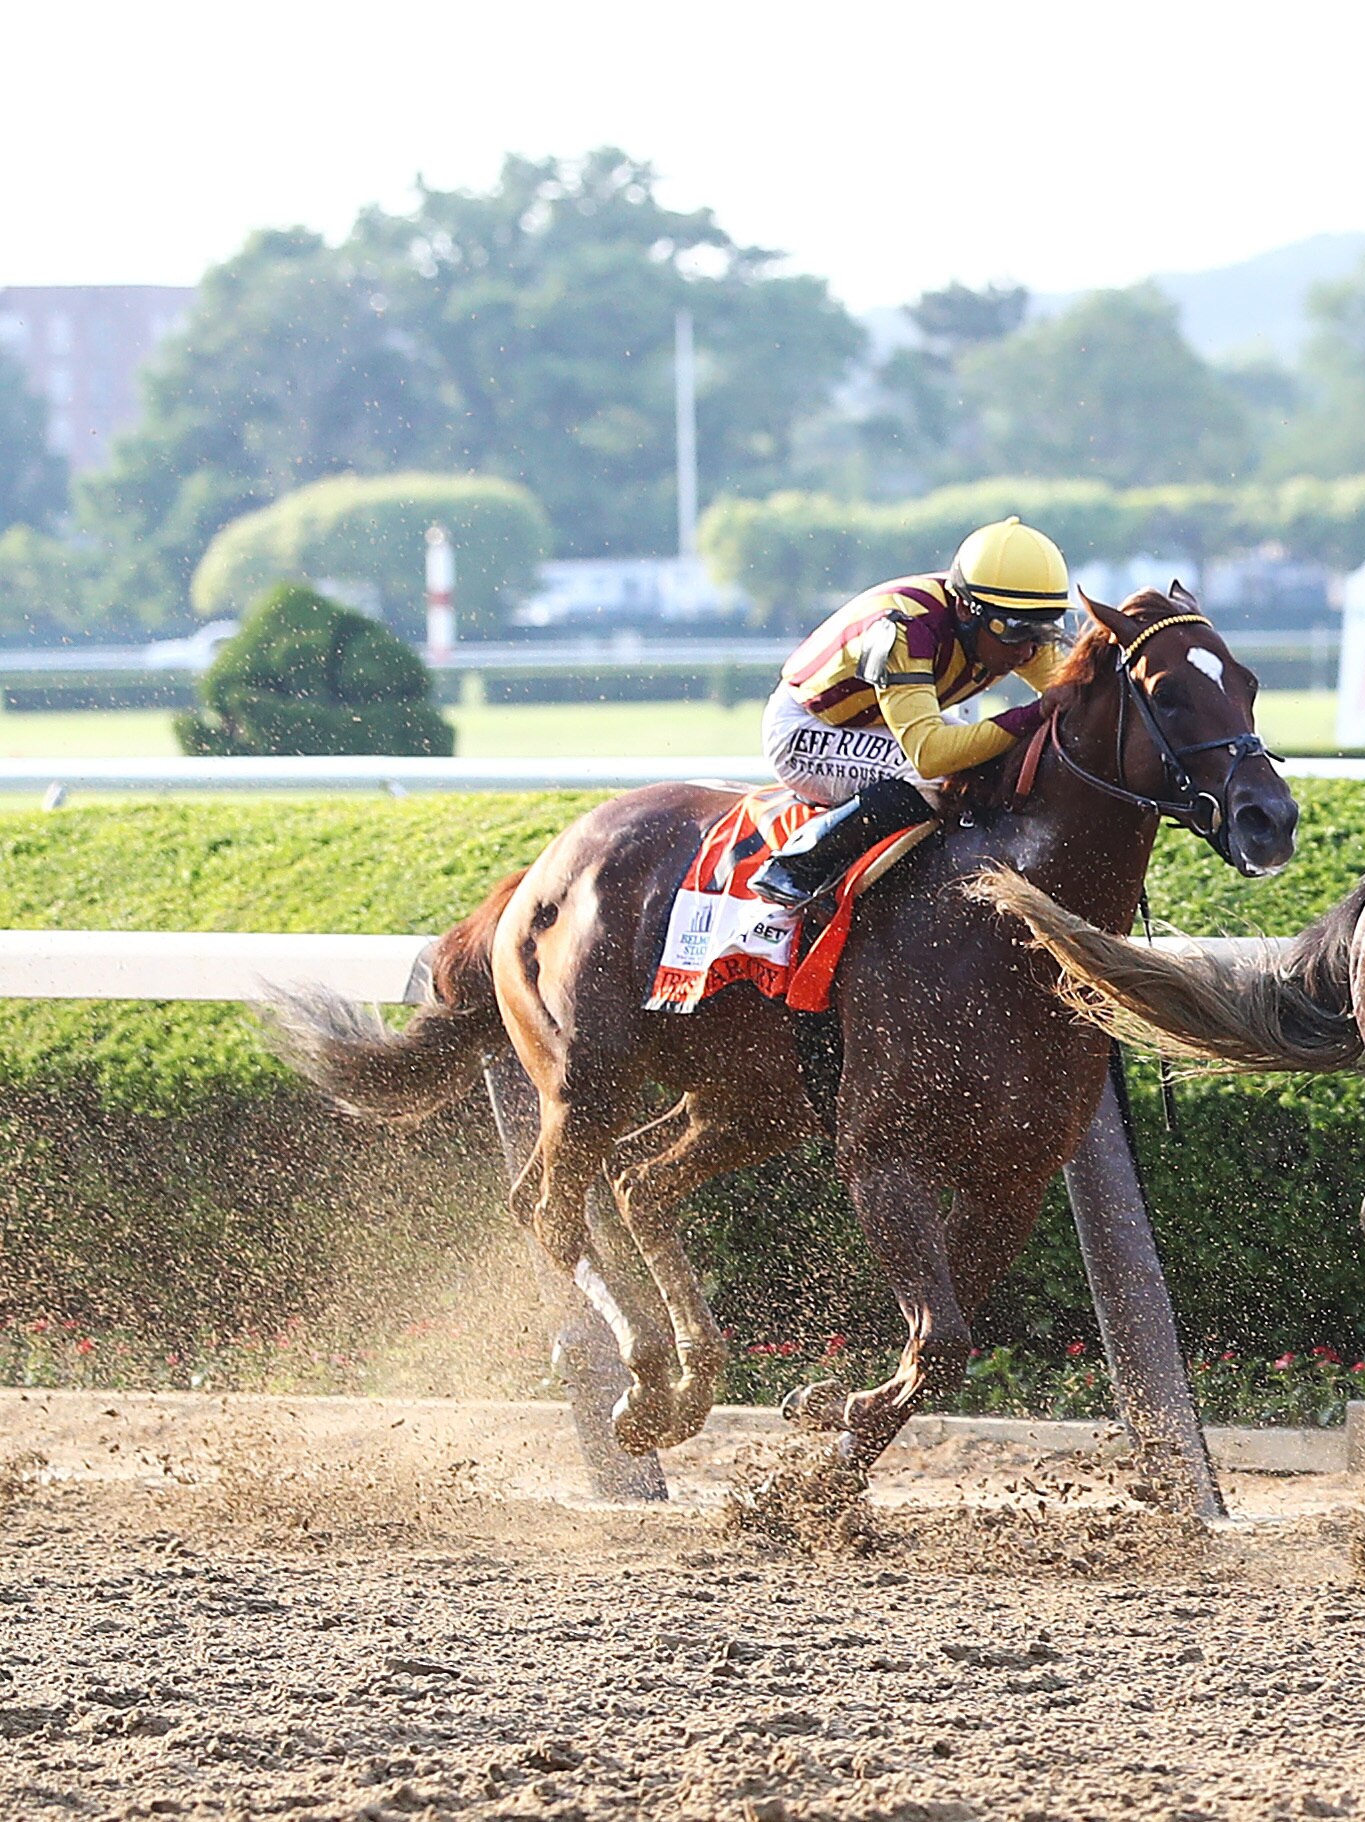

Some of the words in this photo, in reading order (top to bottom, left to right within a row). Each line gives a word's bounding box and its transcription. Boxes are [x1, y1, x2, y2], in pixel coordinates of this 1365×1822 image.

[788, 729, 836, 755] JEFF
[837, 729, 907, 767] RUBYS
[753, 921, 788, 941] BET
